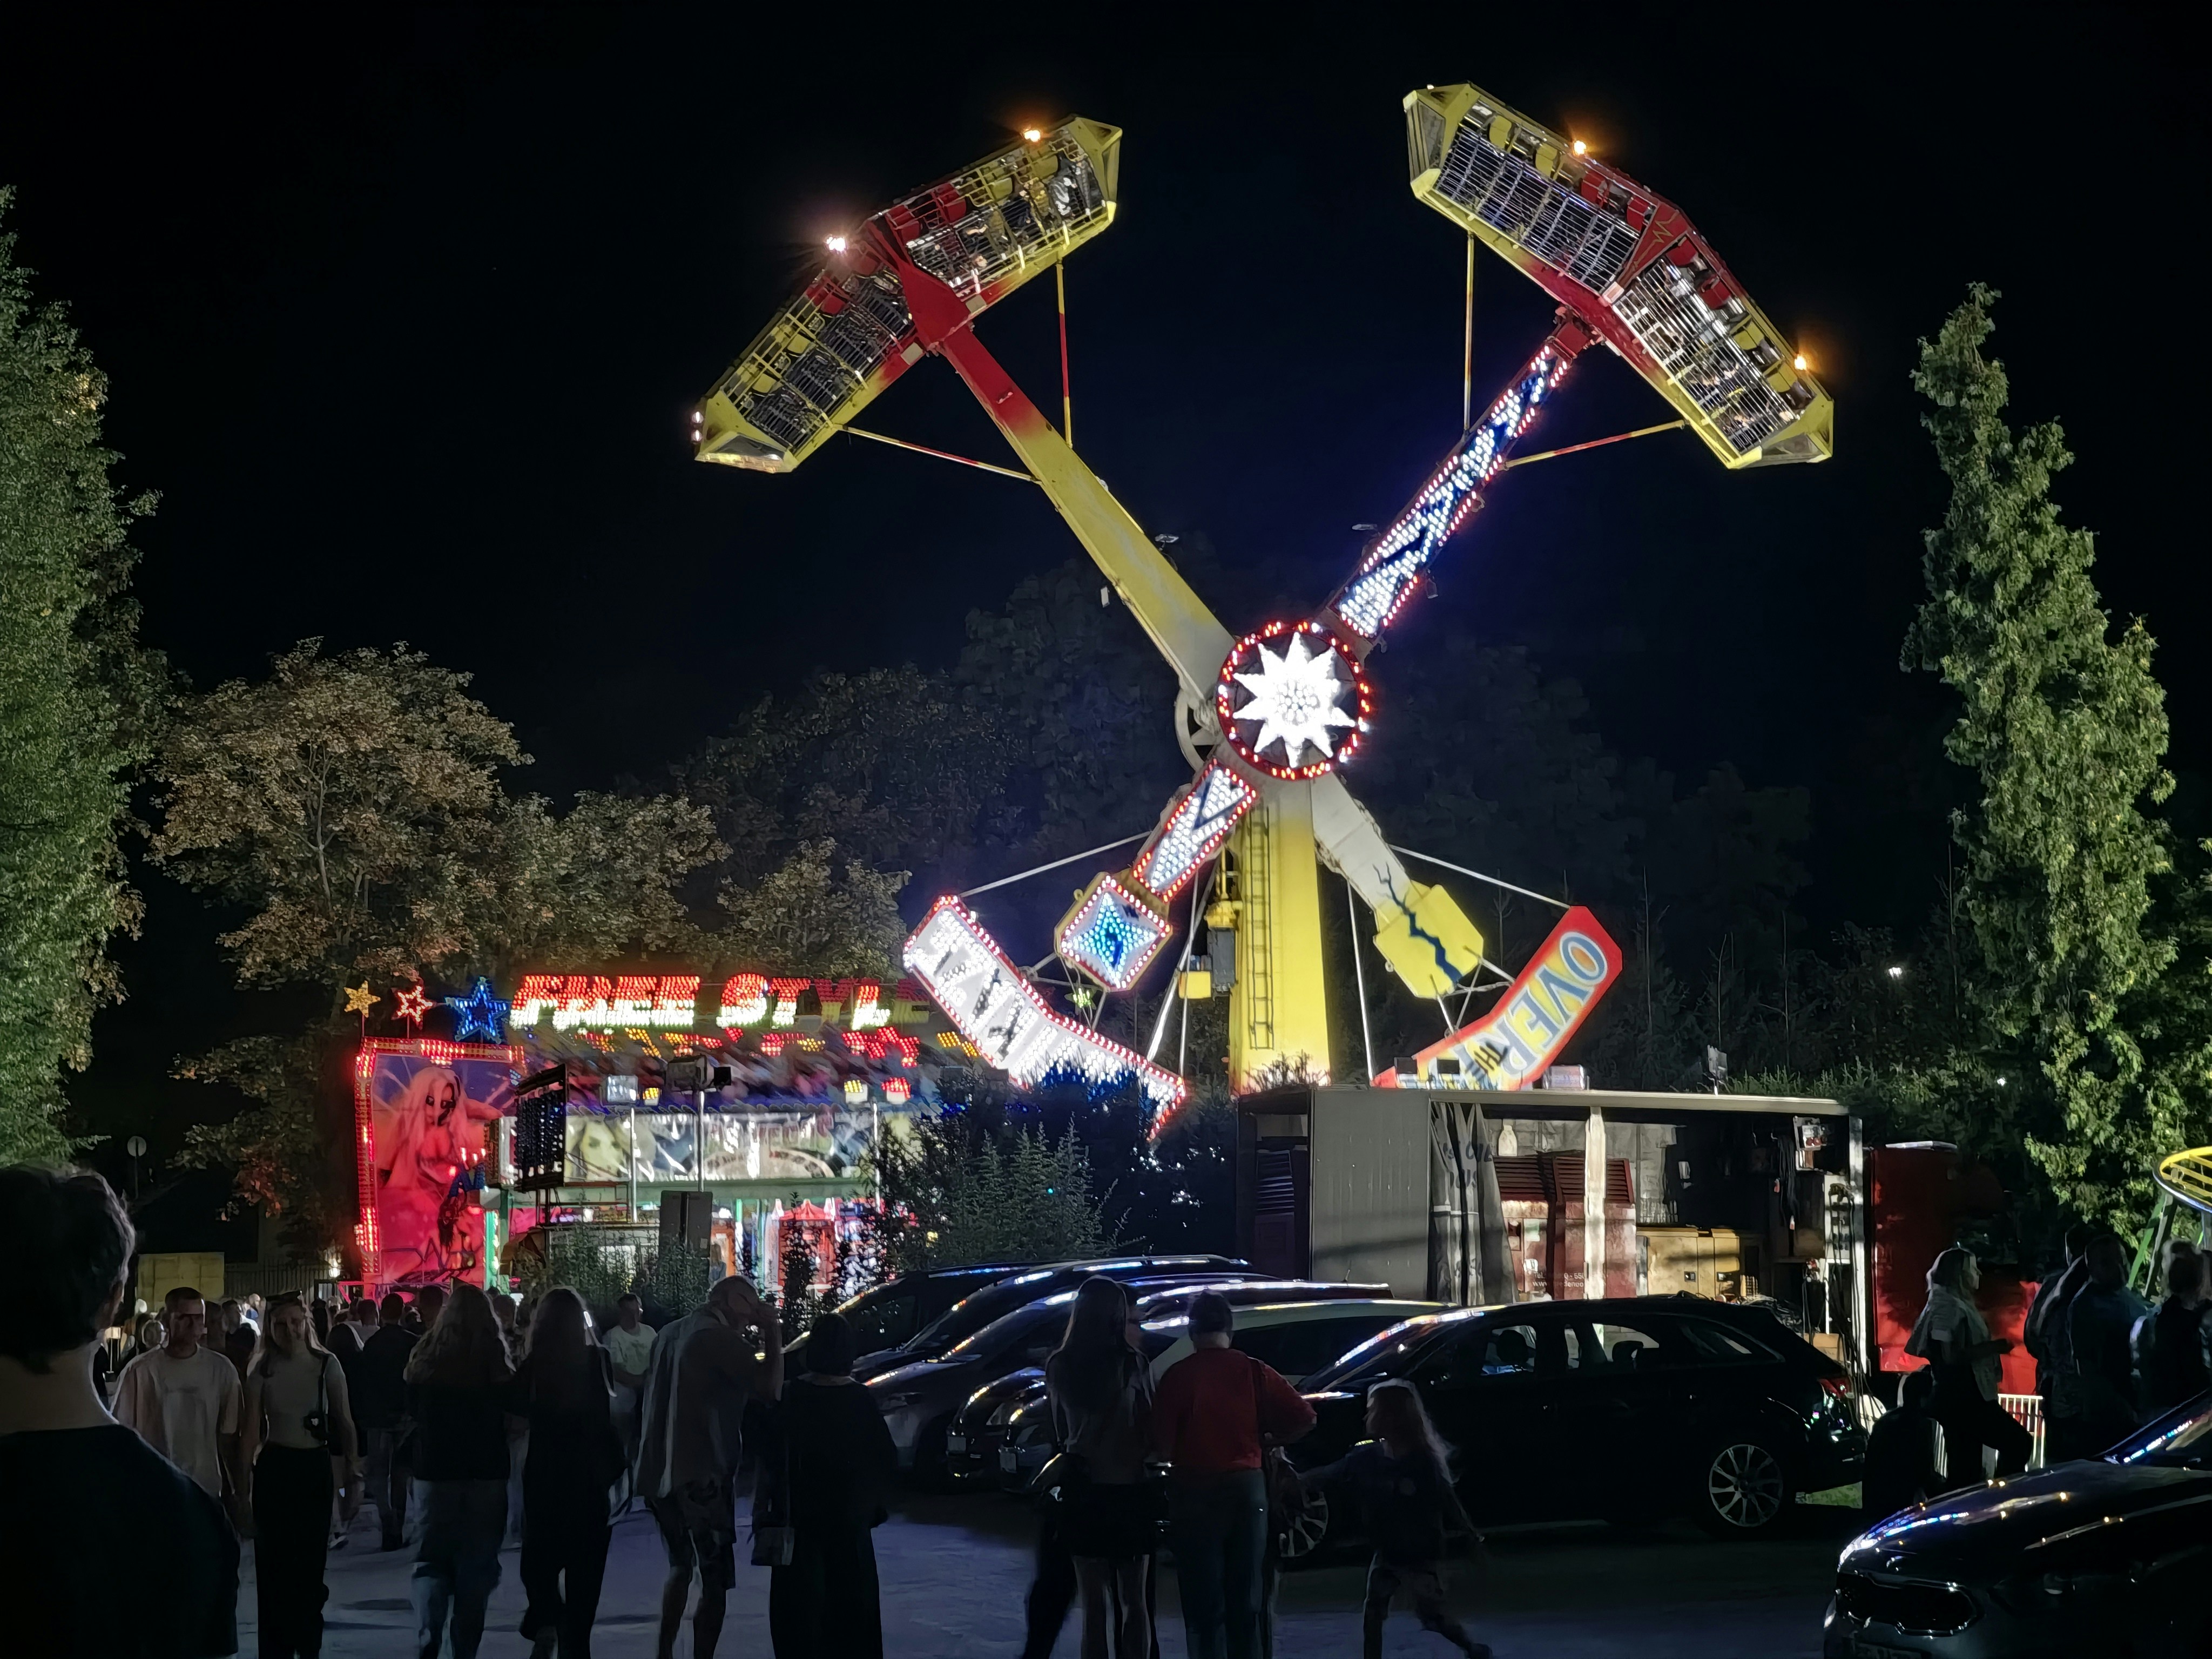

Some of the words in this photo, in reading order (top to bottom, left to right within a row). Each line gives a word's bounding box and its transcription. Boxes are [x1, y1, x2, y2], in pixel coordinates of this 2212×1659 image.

[509, 974, 700, 1029] FREE
[716, 973, 931, 1029] STYLE
[1466, 931, 1608, 1077] OVER
